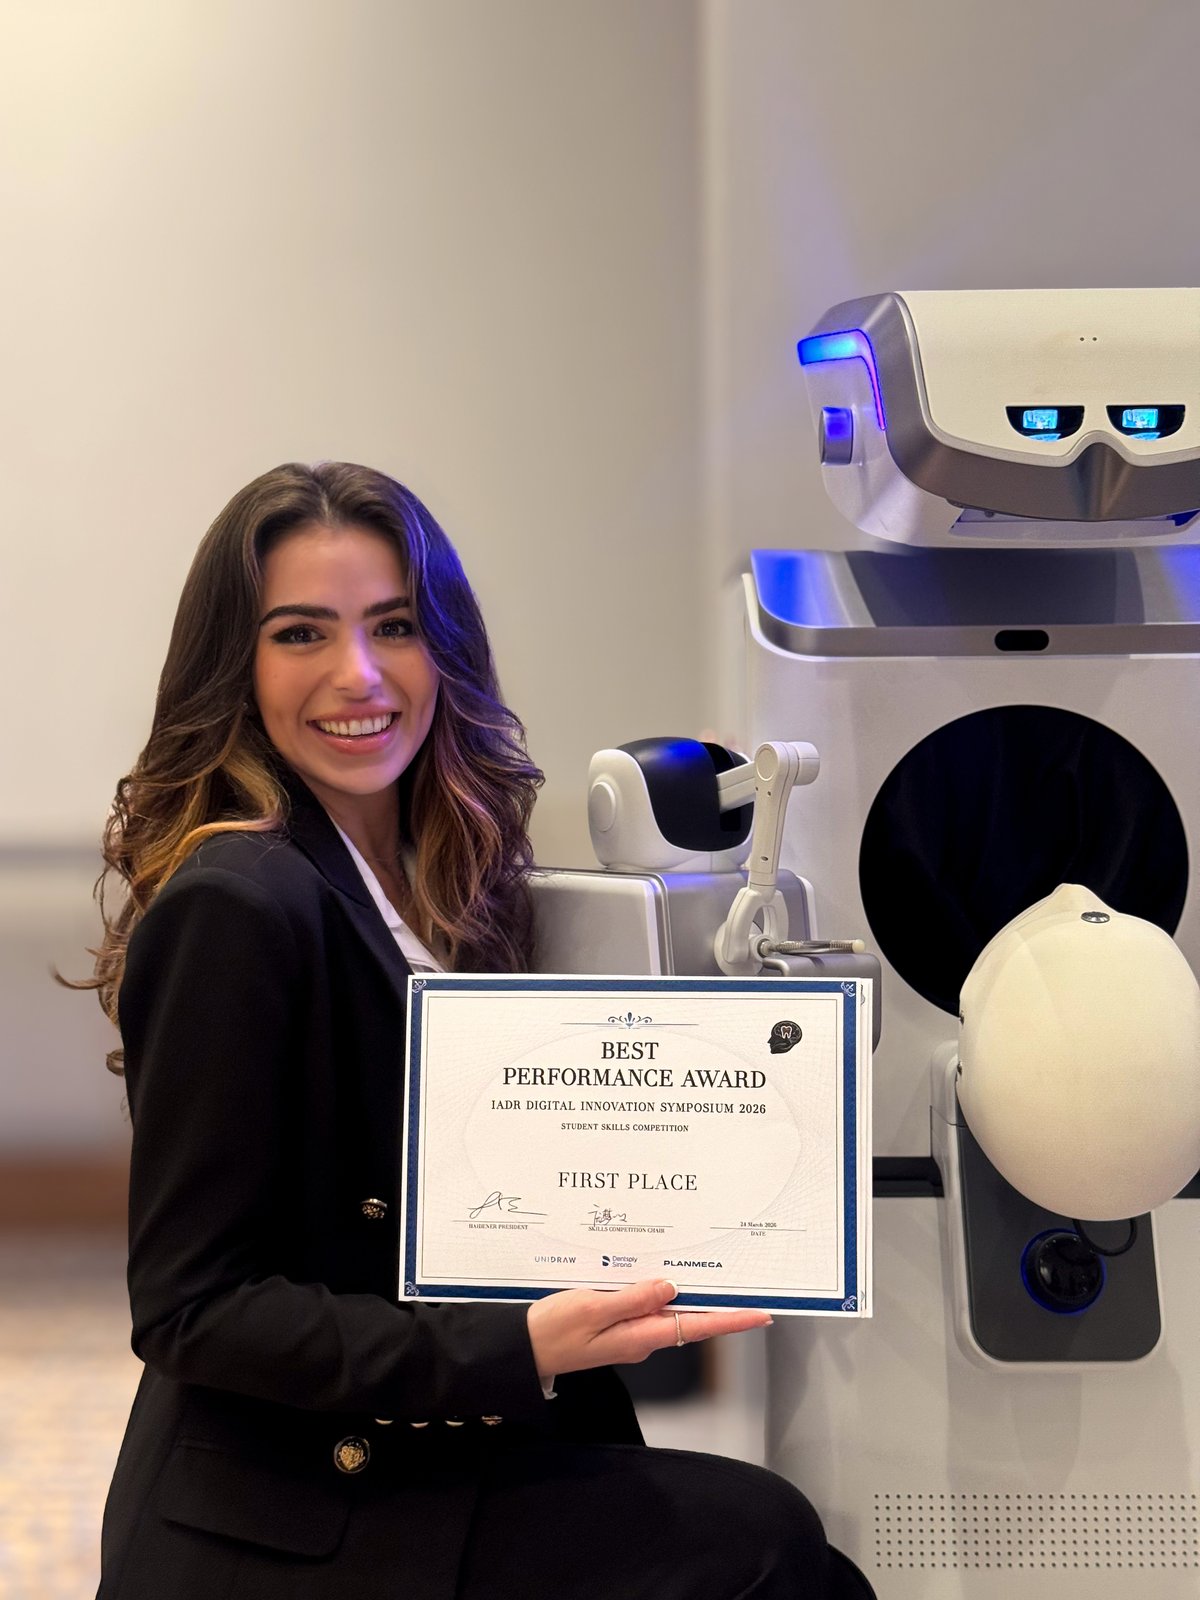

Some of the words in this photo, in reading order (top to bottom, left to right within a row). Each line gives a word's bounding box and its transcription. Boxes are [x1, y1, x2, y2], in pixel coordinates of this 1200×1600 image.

[601, 1041, 660, 1060] BEST
[503, 1067, 674, 1088] PERFORMANCE
[681, 1069, 767, 1089] AWARD
[491, 1100, 521, 1110] IADR
[526, 1100, 576, 1111] DIGITAL
[581, 1101, 655, 1112] INNOVATION
[659, 1102, 734, 1114] SYMPOSIUM
[739, 1103, 766, 1115] 2026
[561, 1123, 599, 1131] STUDENT
[601, 1123, 631, 1131] SKILLS
[633, 1124, 689, 1132] COMPETITION
[558, 1172, 620, 1189] FIRST
[628, 1173, 698, 1191] PLACE
[498, 1223, 529, 1231] PRESIDENT
[534, 1256, 577, 1264] UNIDRAW
[612, 1255, 638, 1263] Dentsply
[663, 1260, 723, 1268] PLANMECA
